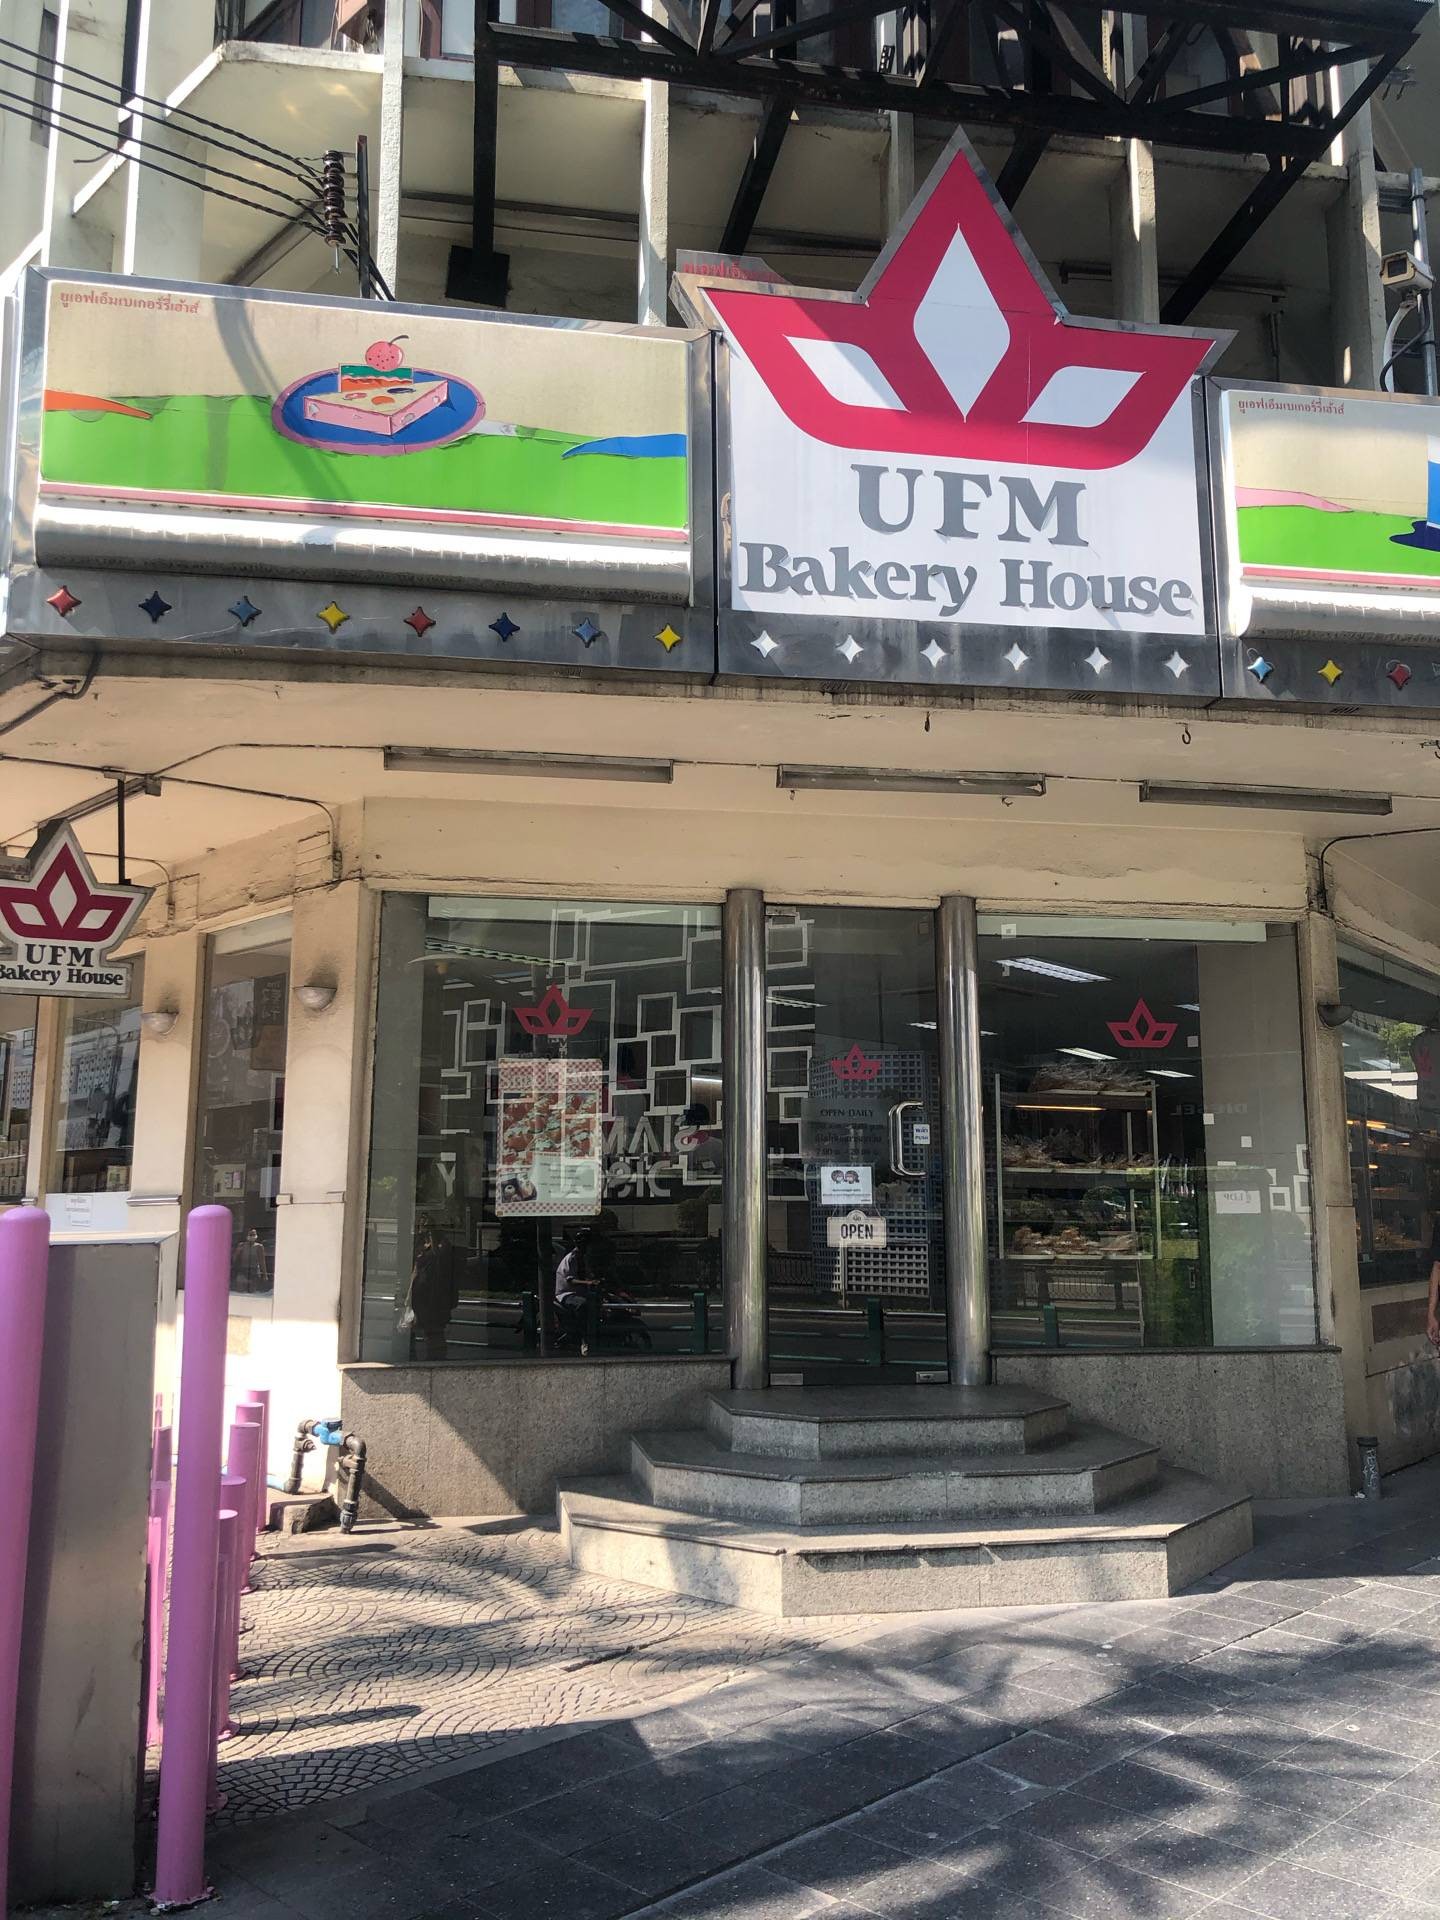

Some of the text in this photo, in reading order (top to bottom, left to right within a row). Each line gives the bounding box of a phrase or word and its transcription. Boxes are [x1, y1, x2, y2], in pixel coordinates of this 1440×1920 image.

[850, 464, 1089, 547] UFM
[739, 542, 1192, 617] Bakery House
[25, 943, 94, 967] UFM
[66, 968, 124, 985] House
[841, 1223, 874, 1240] OPEN
